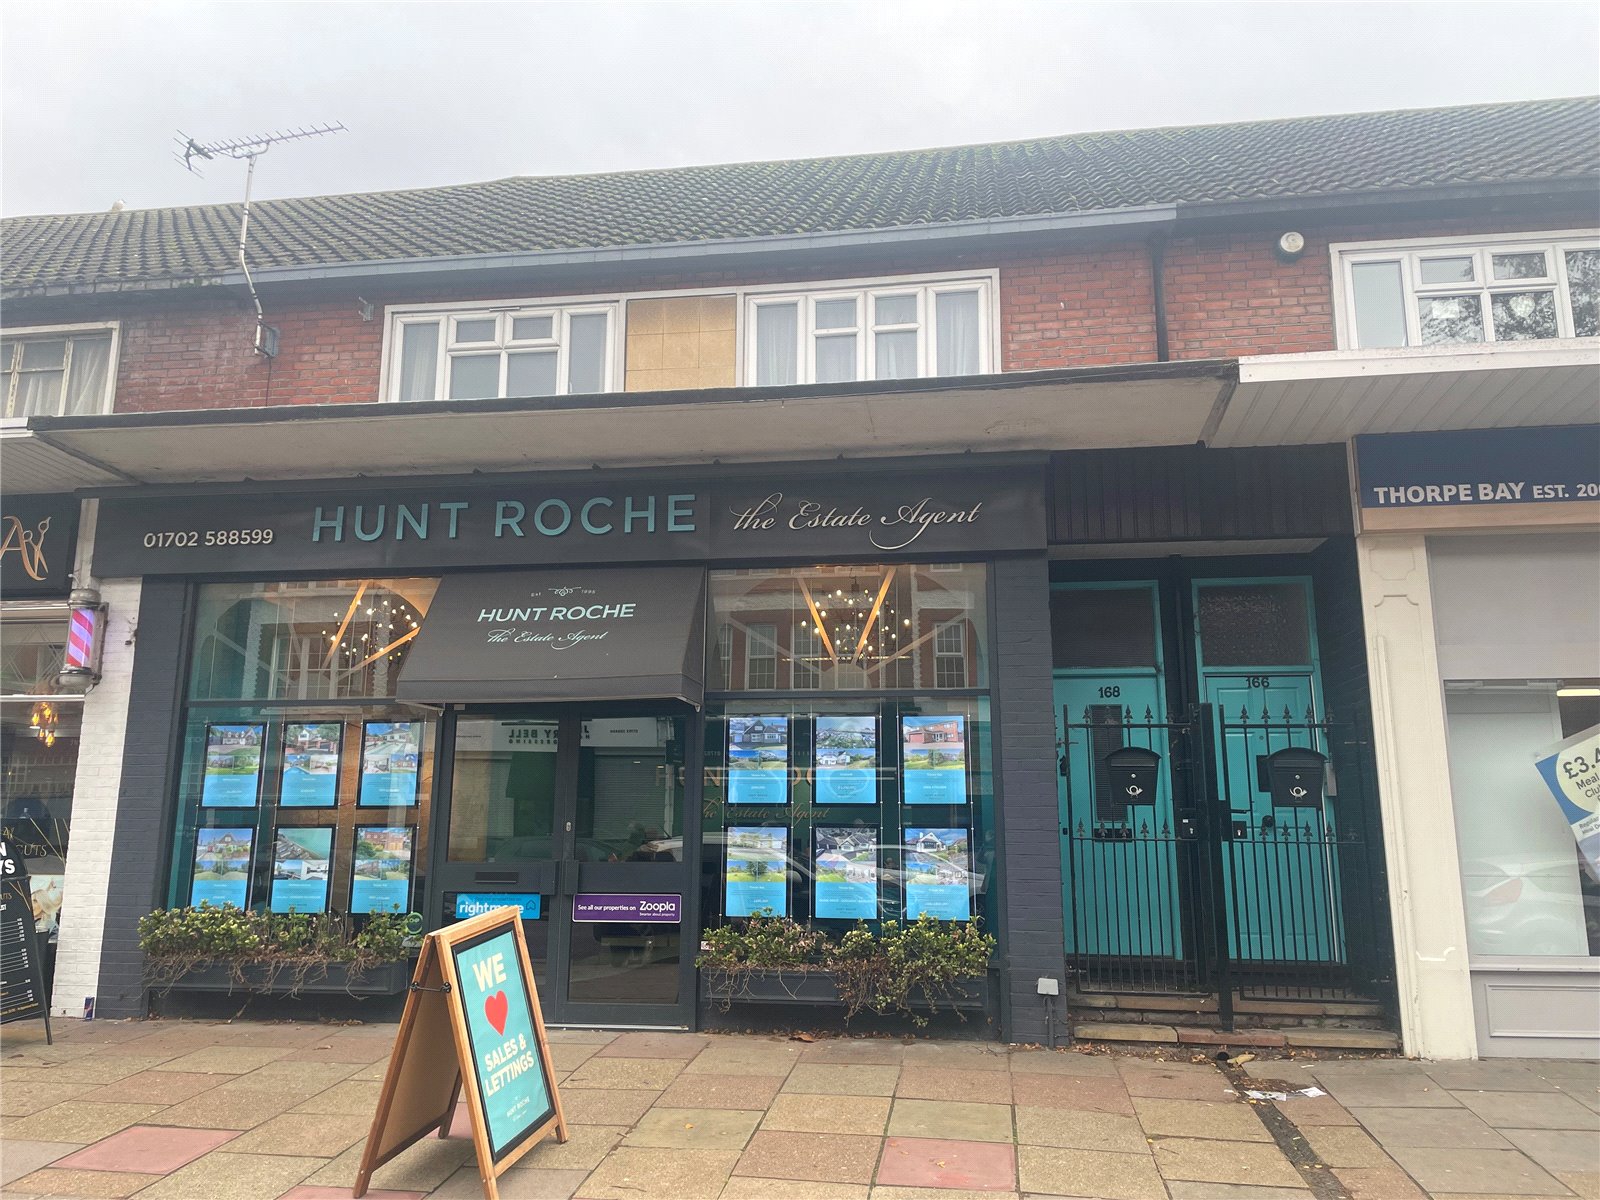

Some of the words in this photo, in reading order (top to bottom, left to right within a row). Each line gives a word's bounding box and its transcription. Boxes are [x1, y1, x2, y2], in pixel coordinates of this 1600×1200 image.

[1373, 484, 1473, 504] THORPE
[1478, 481, 1525, 501] BAY
[1533, 484, 1569, 499] EST.
[1576, 483, 1600, 498] 20
[311, 501, 470, 542] HUNT
[494, 493, 697, 539] ROCHE
[729, 492, 783, 532] the
[788, 500, 872, 532] Estate
[868, 497, 983, 550] Agent
[143, 531, 199, 549] 01702
[204, 527, 274, 547] 588599
[477, 607, 547, 622] HUNT
[549, 603, 637, 621] ROCHE
[487, 628, 516, 643] The
[514, 631, 554, 643] Estate
[551, 629, 609, 650] Agent
[1098, 686, 1121, 699] 168
[1246, 676, 1270, 689] 166
[1576, 773, 1600, 790] Meal
[460, 901, 524, 917] rightme
[603, 904, 629, 912] properties
[639, 901, 676, 912] Zoopla
[472, 952, 507, 993] WE
[484, 1039, 519, 1072] SALES
[519, 1033, 527, 1051] &
[484, 1050, 535, 1098] LETTINGS
